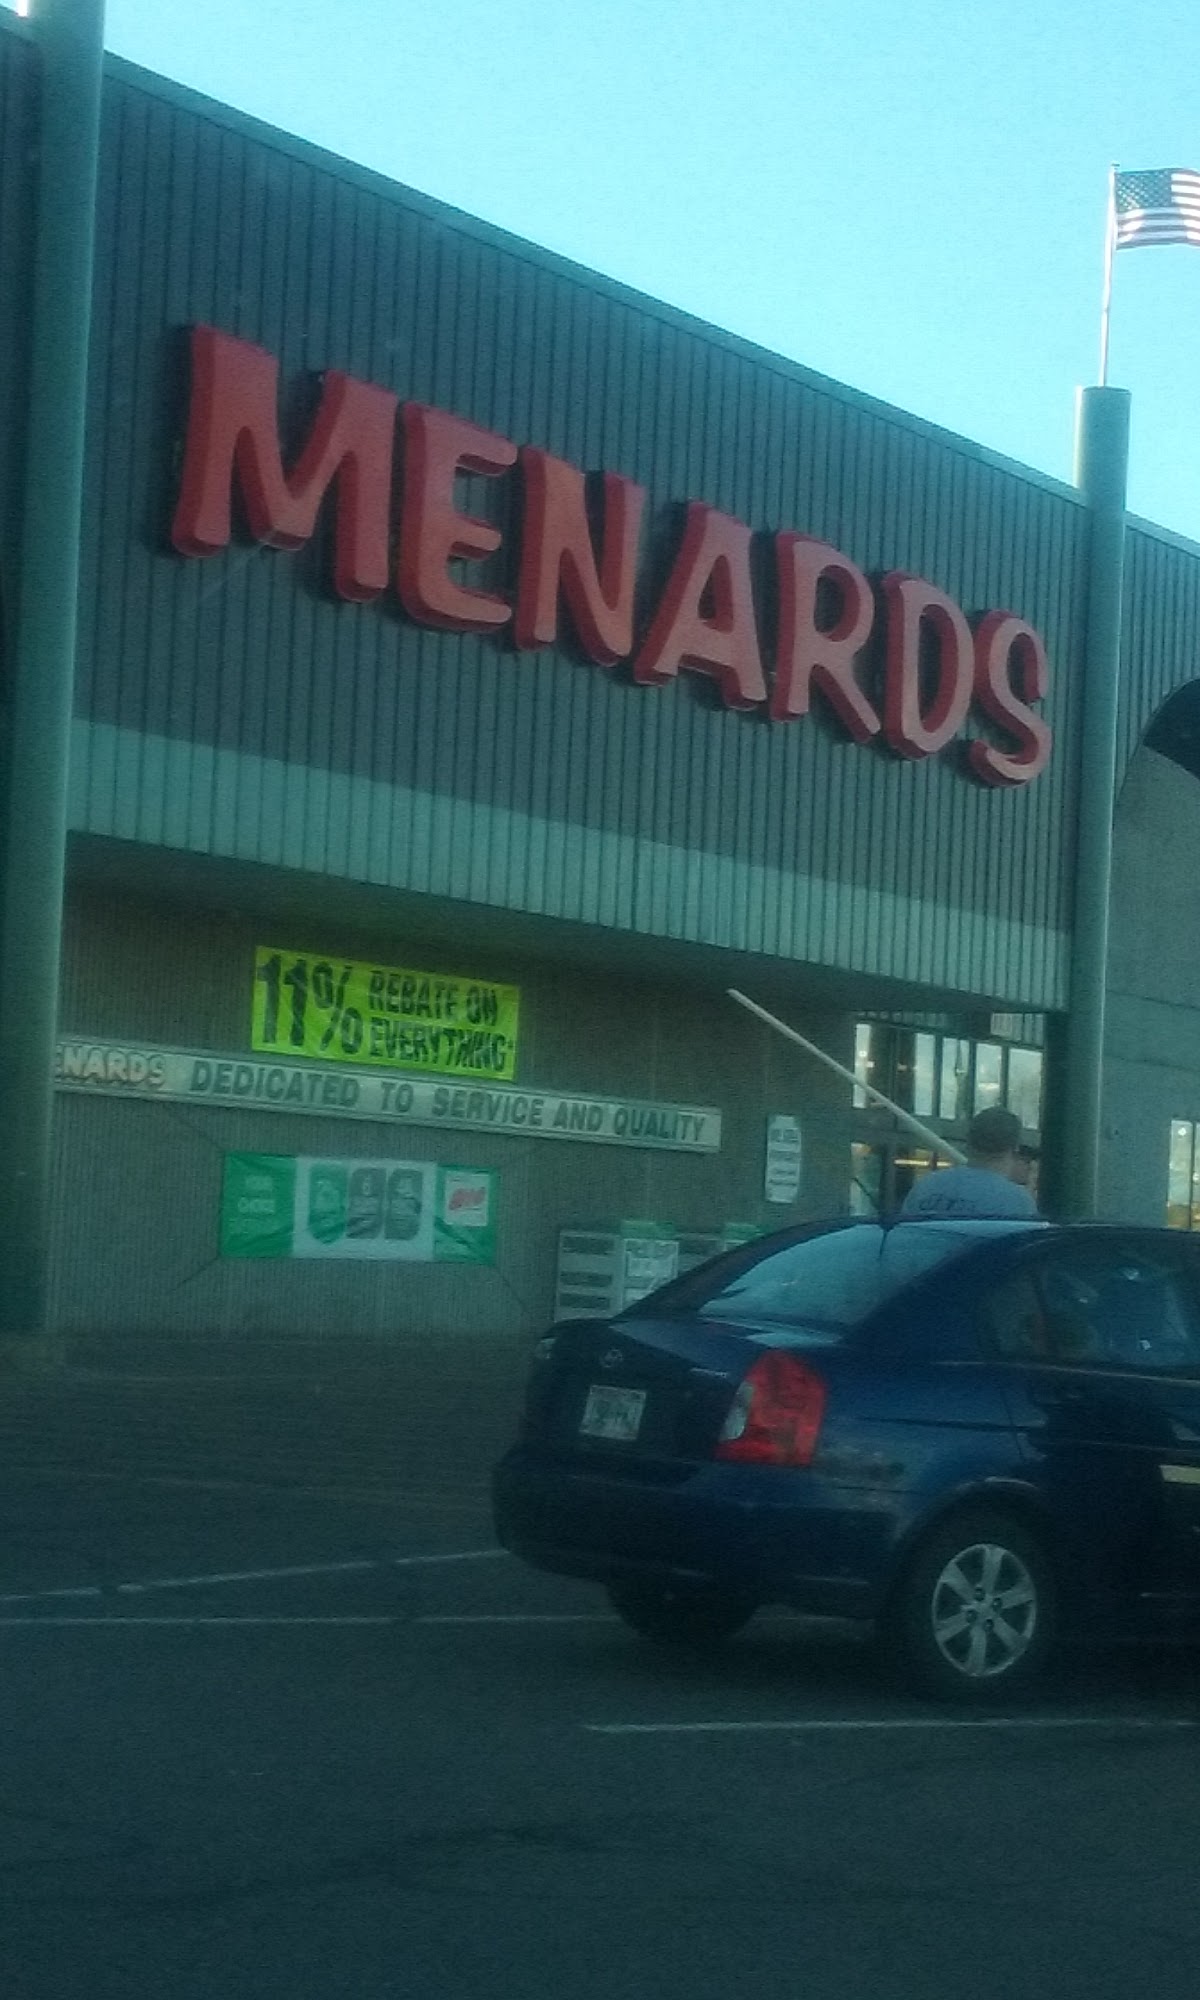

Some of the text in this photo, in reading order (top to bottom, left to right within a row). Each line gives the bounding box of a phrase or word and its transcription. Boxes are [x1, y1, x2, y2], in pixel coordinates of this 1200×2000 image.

[172, 323, 1053, 787] MENARDS
[257, 954, 365, 1054] 11%
[368, 970, 498, 1026] REBATE ON
[369, 1017, 508, 1071] EVERYTHING
[190, 1060, 359, 1105] DEDICATED
[379, 1081, 414, 1113] TO
[431, 1087, 544, 1127] SERVICE
[552, 1099, 605, 1132] AND
[612, 1107, 707, 1141] QUALITY
